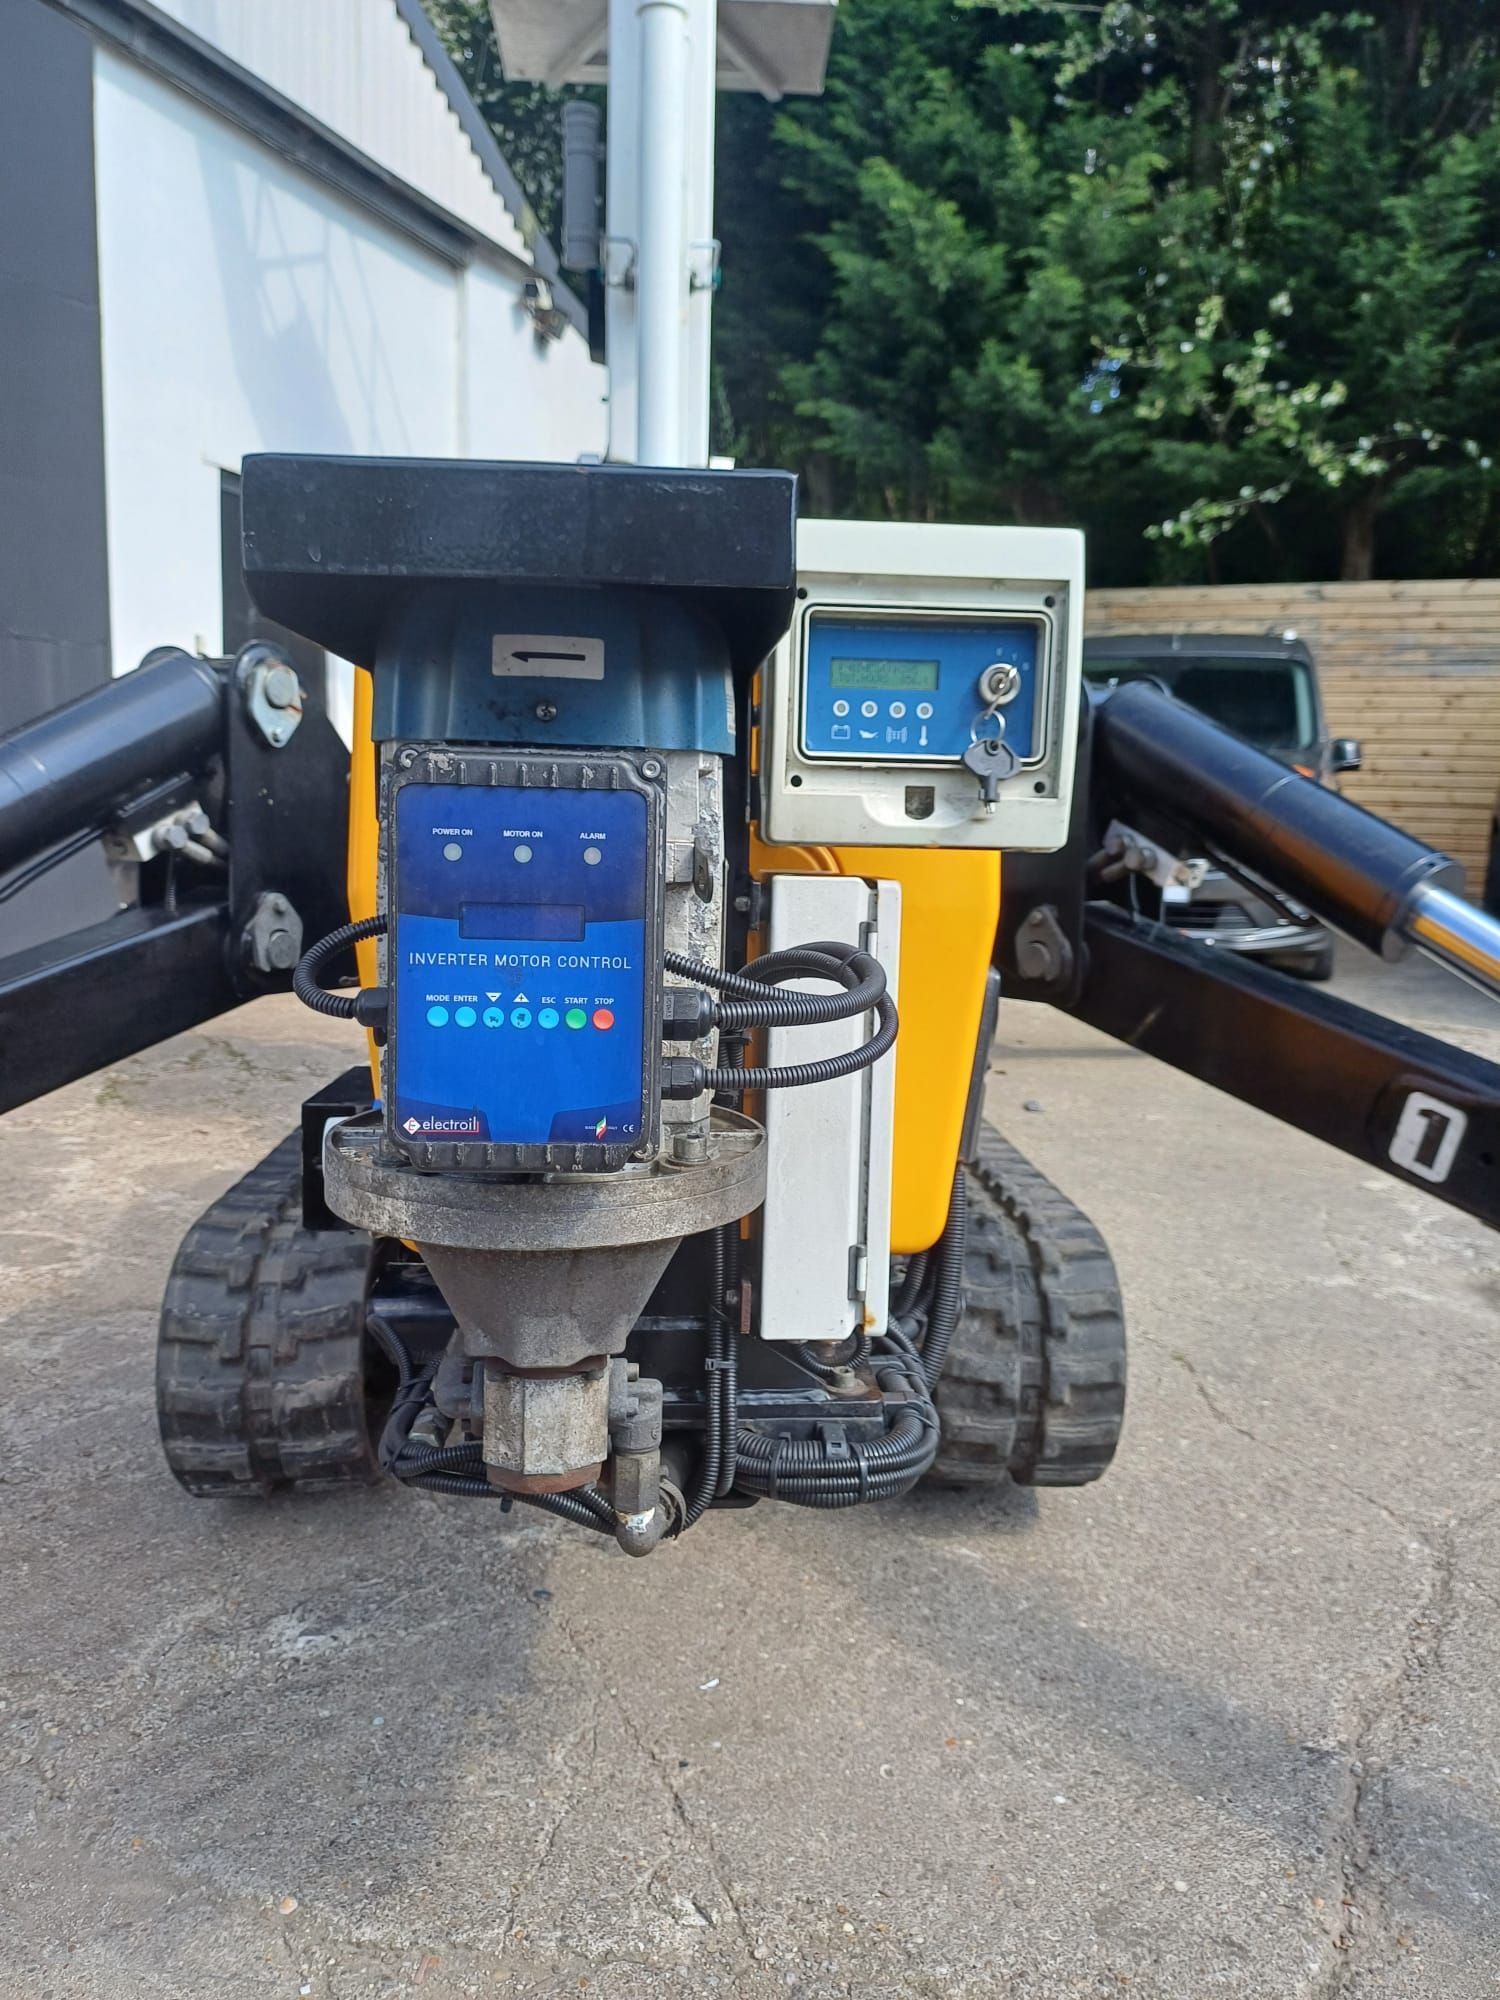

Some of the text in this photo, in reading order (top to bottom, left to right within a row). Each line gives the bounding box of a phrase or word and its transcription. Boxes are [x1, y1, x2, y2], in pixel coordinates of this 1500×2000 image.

[432, 827, 473, 836] POWER ON
[503, 830, 530, 838] MOTOR
[579, 832, 606, 840] ALARM
[409, 952, 632, 969] INVERTER MOTOR CONTROL
[425, 994, 450, 1002] MODE
[453, 994, 478, 1003] ENTER
[541, 996, 557, 1004] ESC
[564, 997, 588, 1005] START
[594, 997, 615, 1005] STOP
[422, 1115, 477, 1131] electroil
